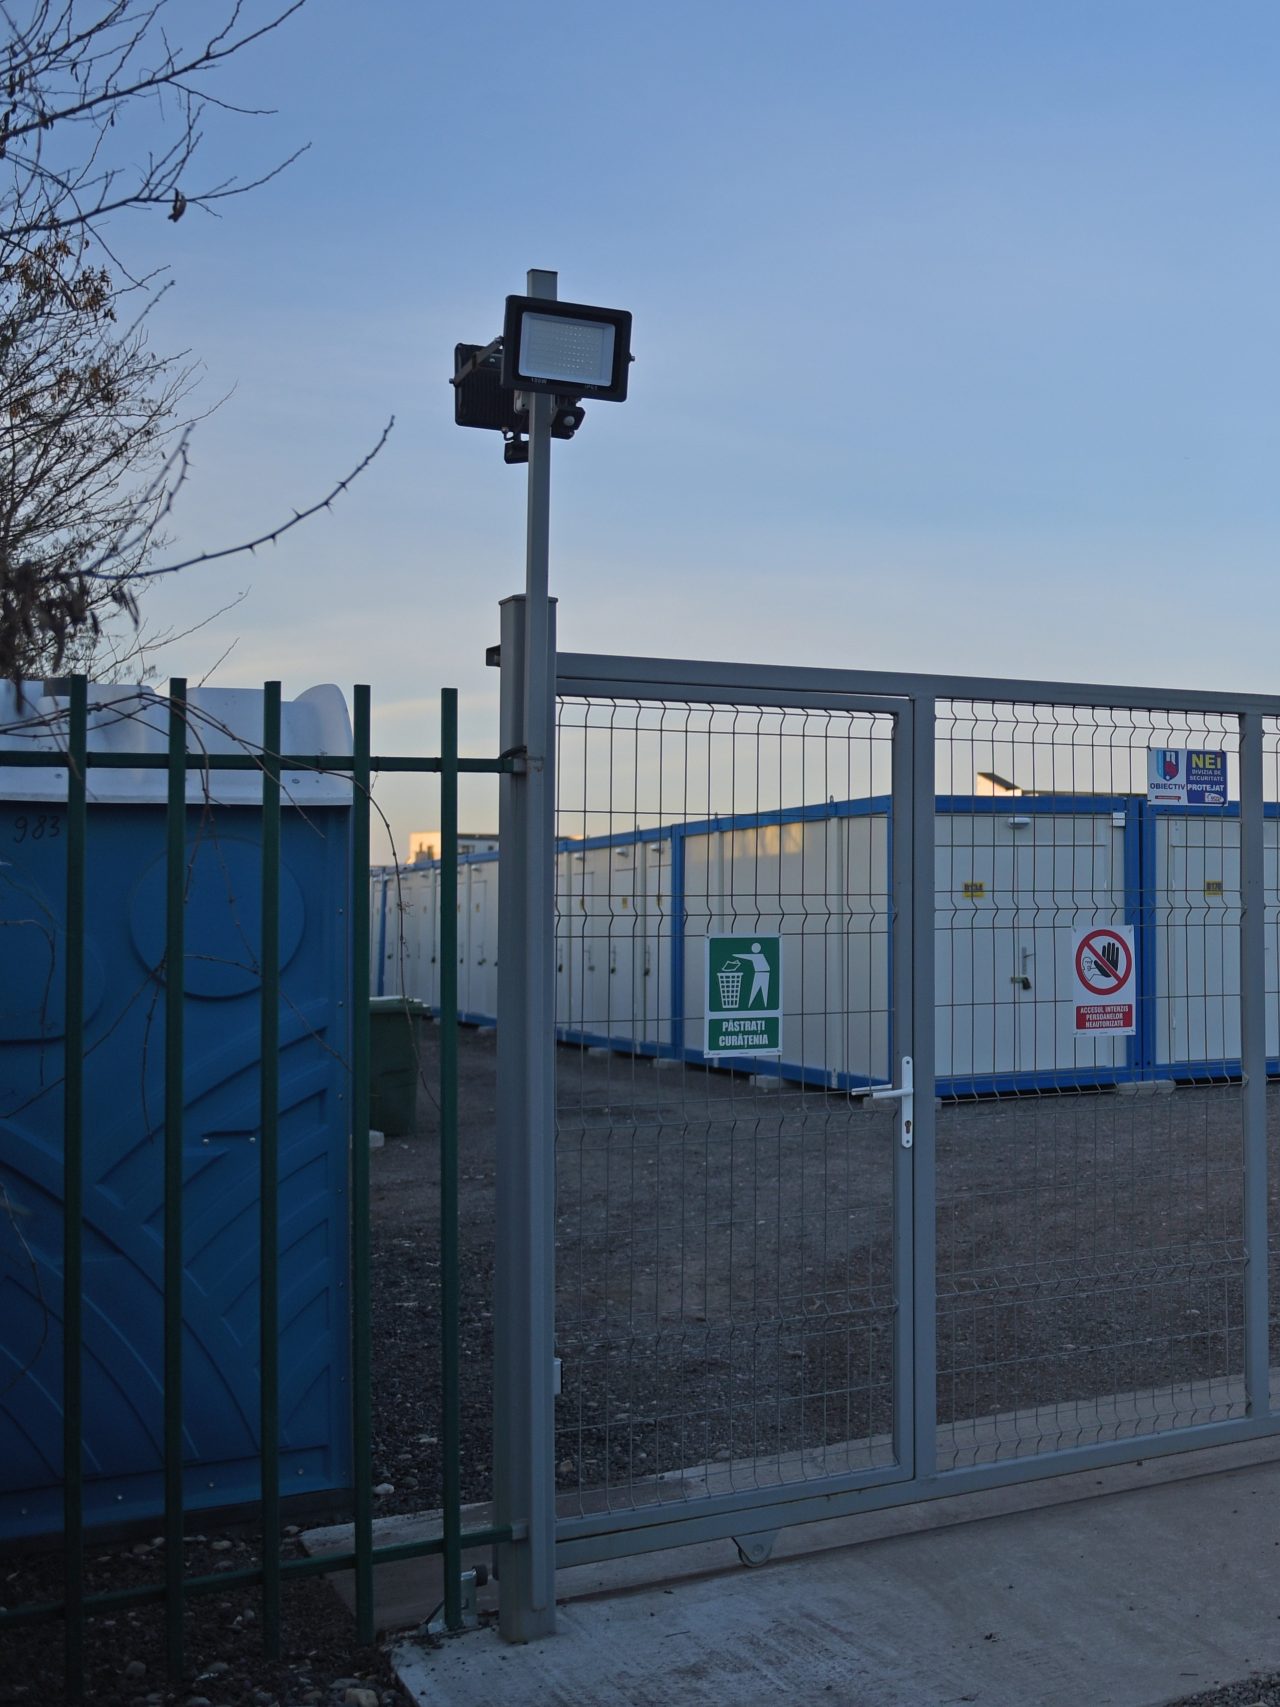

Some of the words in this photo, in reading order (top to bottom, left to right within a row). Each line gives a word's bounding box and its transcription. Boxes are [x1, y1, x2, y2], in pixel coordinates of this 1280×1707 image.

[1149, 782, 1186, 791] OBIECTIV
[1187, 783, 1225, 792] PROTEJAT
[14, 815, 61, 844] 983
[1080, 1006, 1105, 1014] ACCESUL
[1104, 1005, 1129, 1013] INTERZIS
[1085, 1012, 1124, 1021] PERSOANELOR
[1085, 1019, 1124, 1028] NEAUTORIZATE
